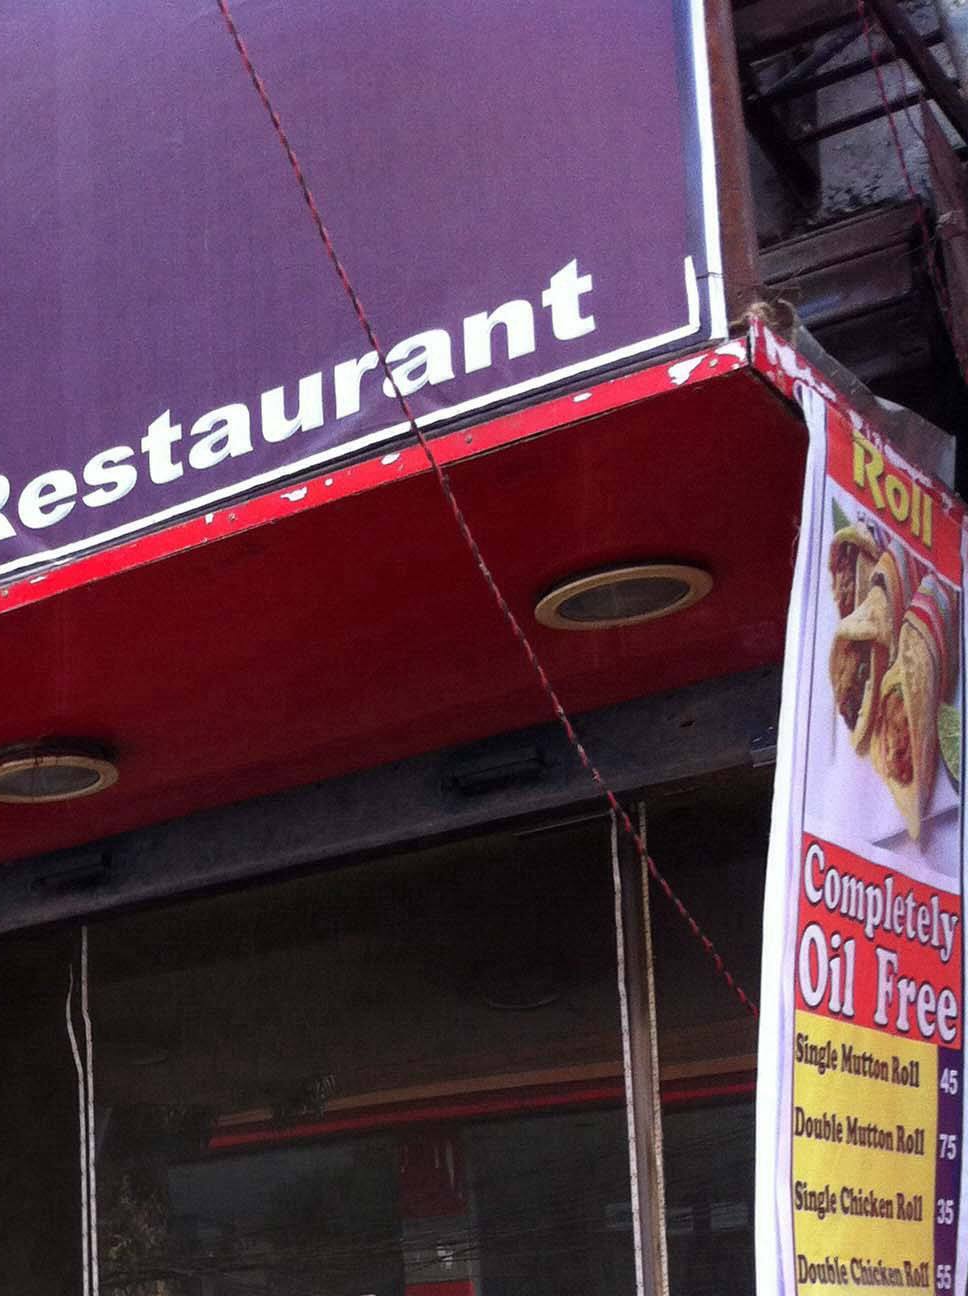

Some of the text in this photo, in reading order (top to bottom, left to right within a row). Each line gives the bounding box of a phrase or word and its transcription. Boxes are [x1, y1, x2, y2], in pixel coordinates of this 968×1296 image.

[851, 429, 934, 549] Roll
[804, 842, 959, 963] Completely
[798, 922, 958, 1042] Oil Free
[795, 1032, 959, 1096] Single Mutton Roll 45
[794, 1106, 957, 1161] Double Mutton Roll 75
[794, 1180, 955, 1225] Single Chicken Roll 35
[797, 1253, 952, 1290] Double Chicken Roll 55
